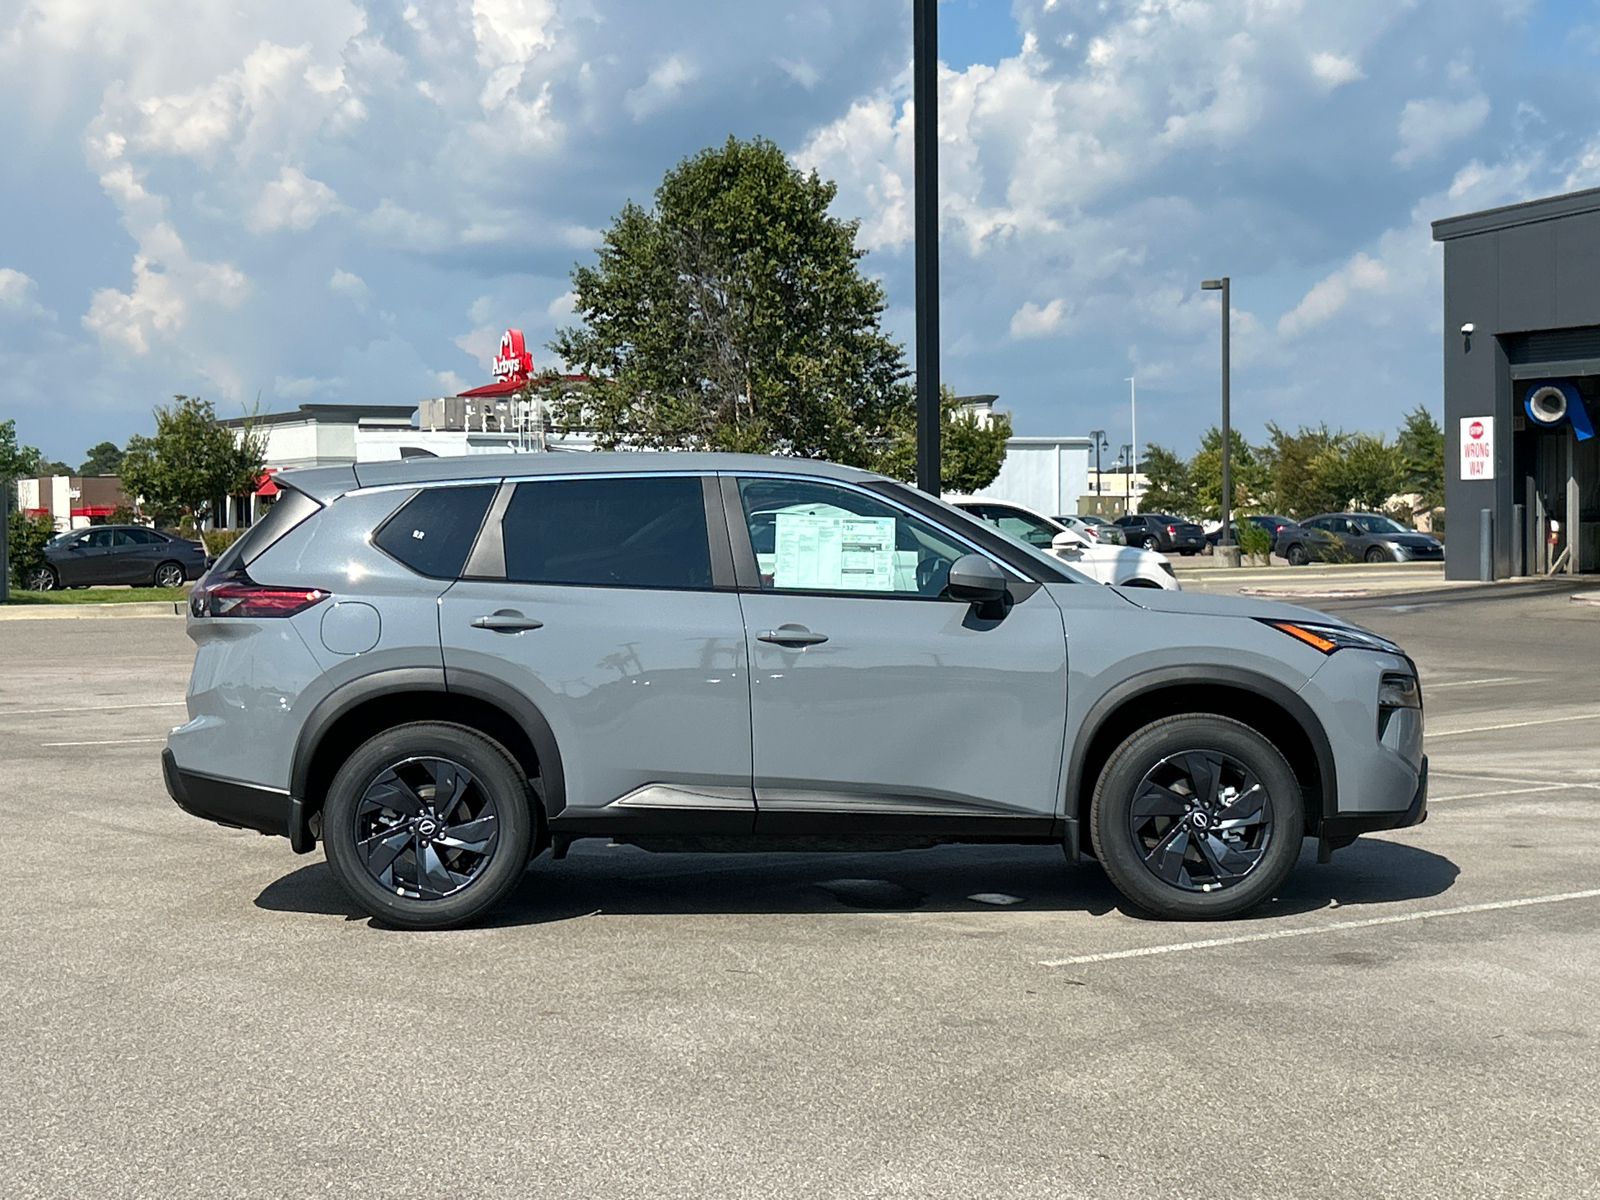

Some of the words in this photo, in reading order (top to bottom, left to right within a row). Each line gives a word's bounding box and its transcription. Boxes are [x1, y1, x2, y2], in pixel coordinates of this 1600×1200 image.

[1469, 426, 1484, 435] STOP
[1464, 442, 1490, 458] WRONG
[1469, 461, 1485, 475] WAY
